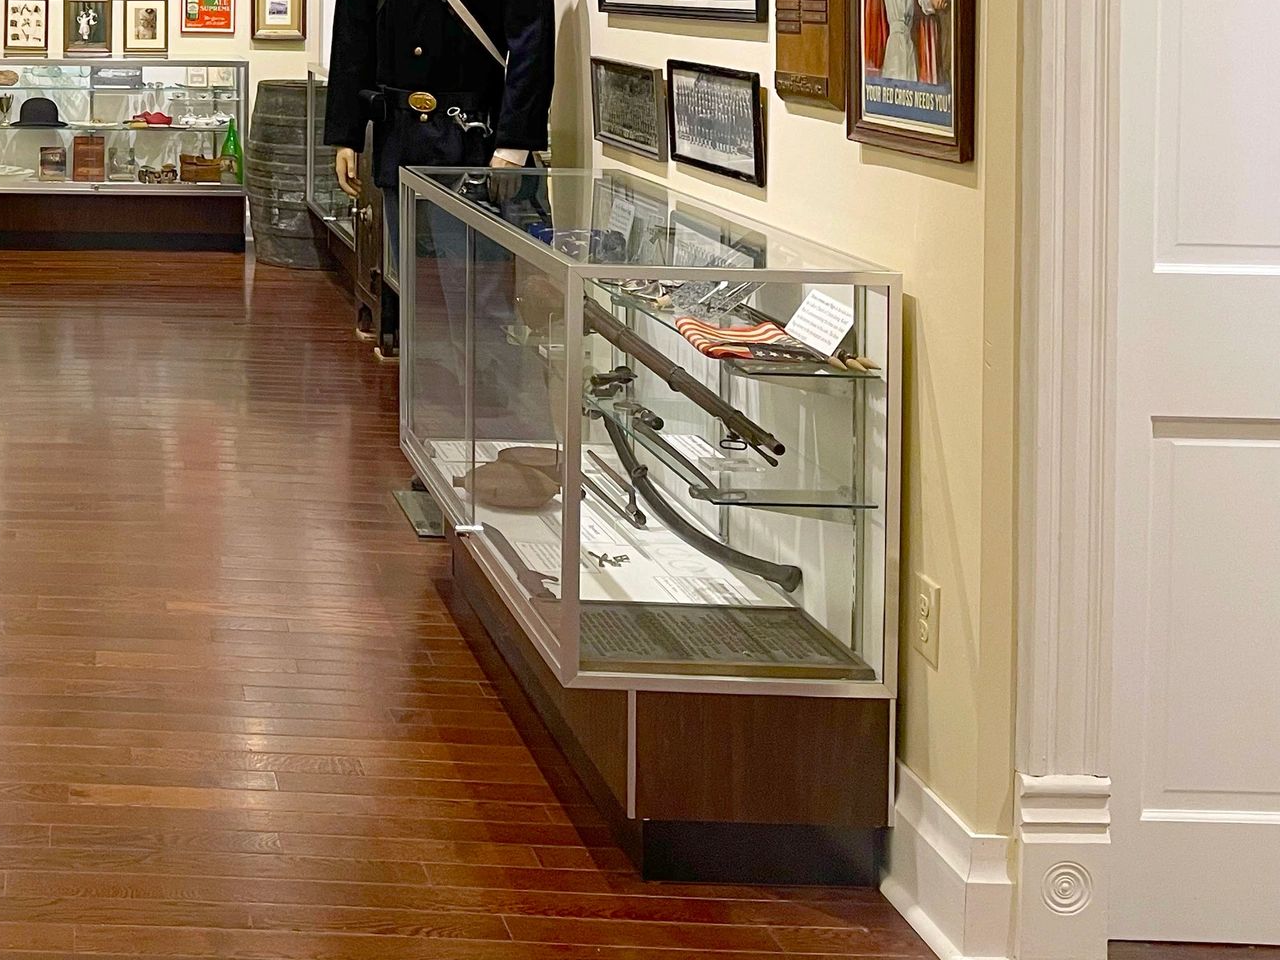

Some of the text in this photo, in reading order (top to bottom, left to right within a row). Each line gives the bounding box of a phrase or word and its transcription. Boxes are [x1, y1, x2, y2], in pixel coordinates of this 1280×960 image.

[866, 84, 951, 113] YOUR RED CROSS NEEDS YOU!
